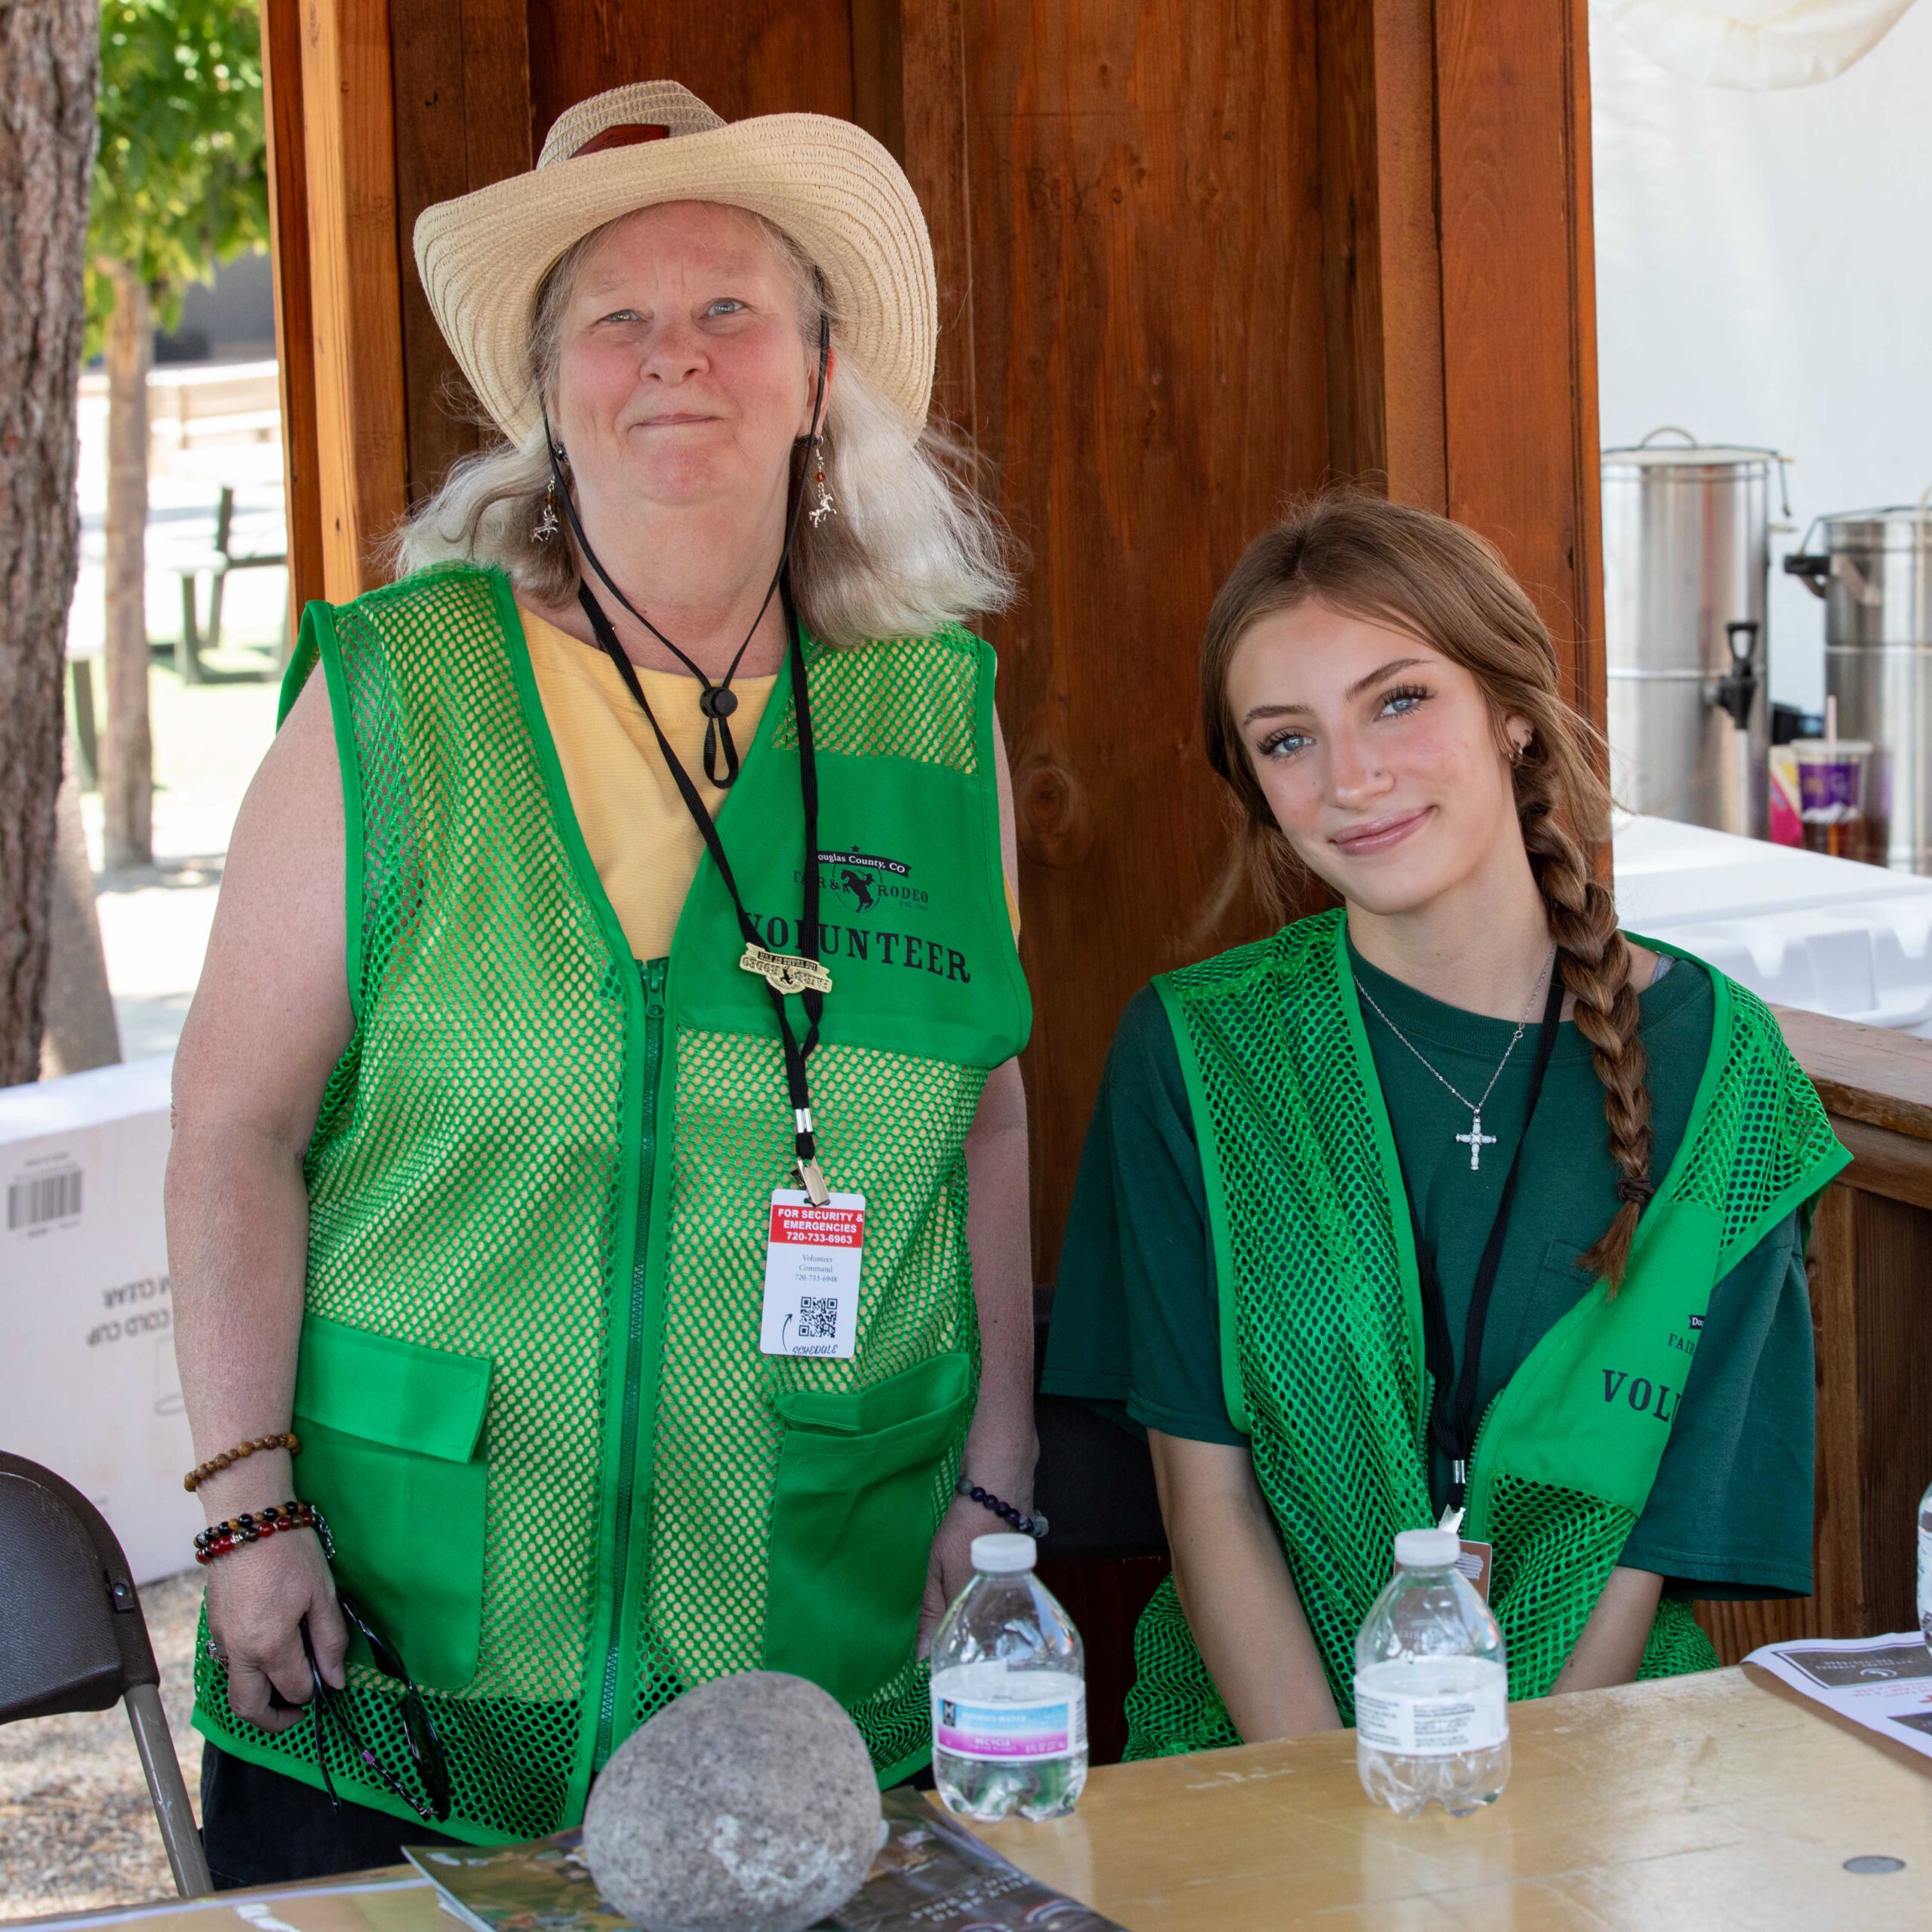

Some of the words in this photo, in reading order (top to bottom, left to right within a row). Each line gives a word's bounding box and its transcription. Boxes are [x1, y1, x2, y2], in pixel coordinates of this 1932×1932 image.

[817, 853, 846, 863] ouglas
[848, 855, 885, 869] County,
[889, 863, 906, 873] CO
[793, 870, 826, 888] FR
[829, 878, 841, 889] &
[877, 884, 929, 903] RODEO
[778, 1208, 798, 1218] FOR
[801, 1210, 854, 1222] SECURITY
[856, 1214, 864, 1223] &
[783, 1220, 857, 1233] EMERGENCIES
[786, 1231, 853, 1244] 720-733-6963
[802, 1254, 833, 1263] Volunteer
[792, 1345, 838, 1355] SCHEDULE
